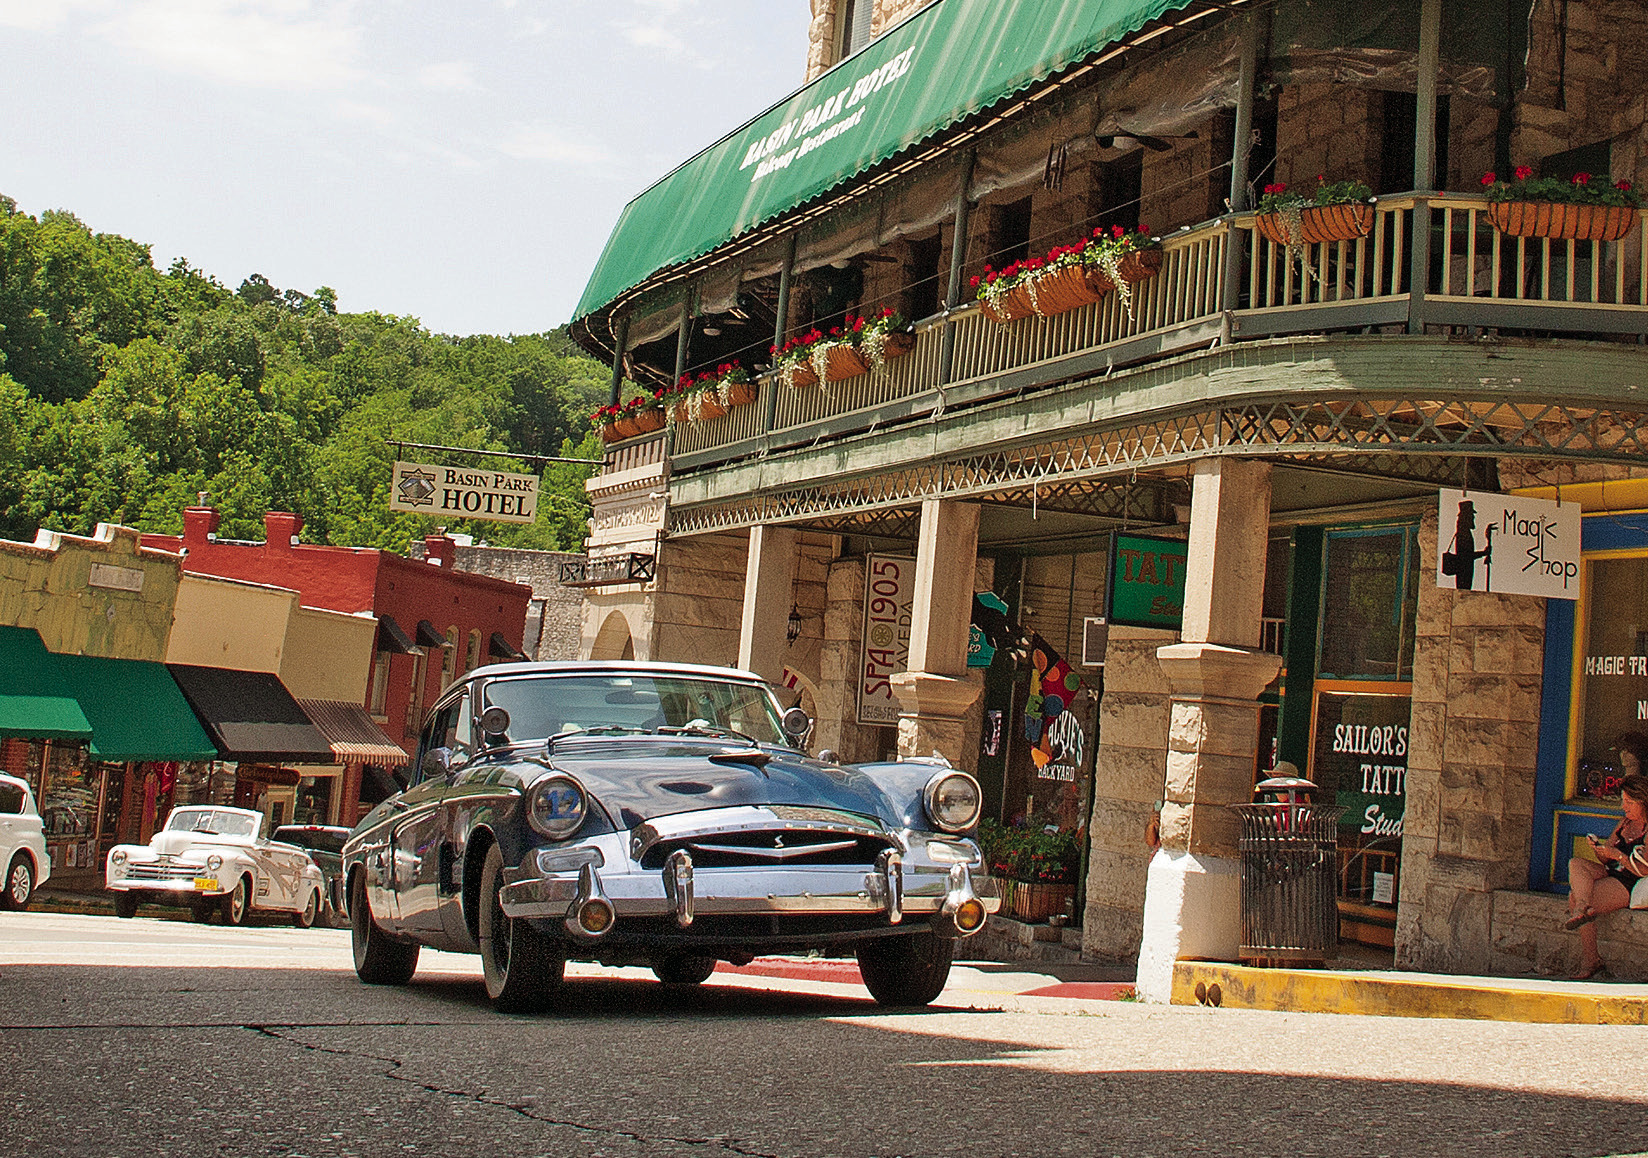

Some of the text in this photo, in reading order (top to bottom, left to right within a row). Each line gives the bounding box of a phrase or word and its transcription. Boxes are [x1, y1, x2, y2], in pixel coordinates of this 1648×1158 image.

[794, 86, 850, 139] PARK
[845, 45, 916, 109] HOTEL
[441, 488, 532, 517] HOTEL
[1503, 509, 1557, 548] Magic
[1521, 535, 1578, 589] Shop
[865, 562, 900, 700] SPA 1905
[897, 600, 914, 668] AVEDA
[1585, 656, 1625, 676] MAGIC
[1333, 724, 1407, 756] SAILOR'S
[1360, 763, 1406, 796] TATT
[546, 789, 580, 820] 12
[1360, 804, 1405, 837] Stud
